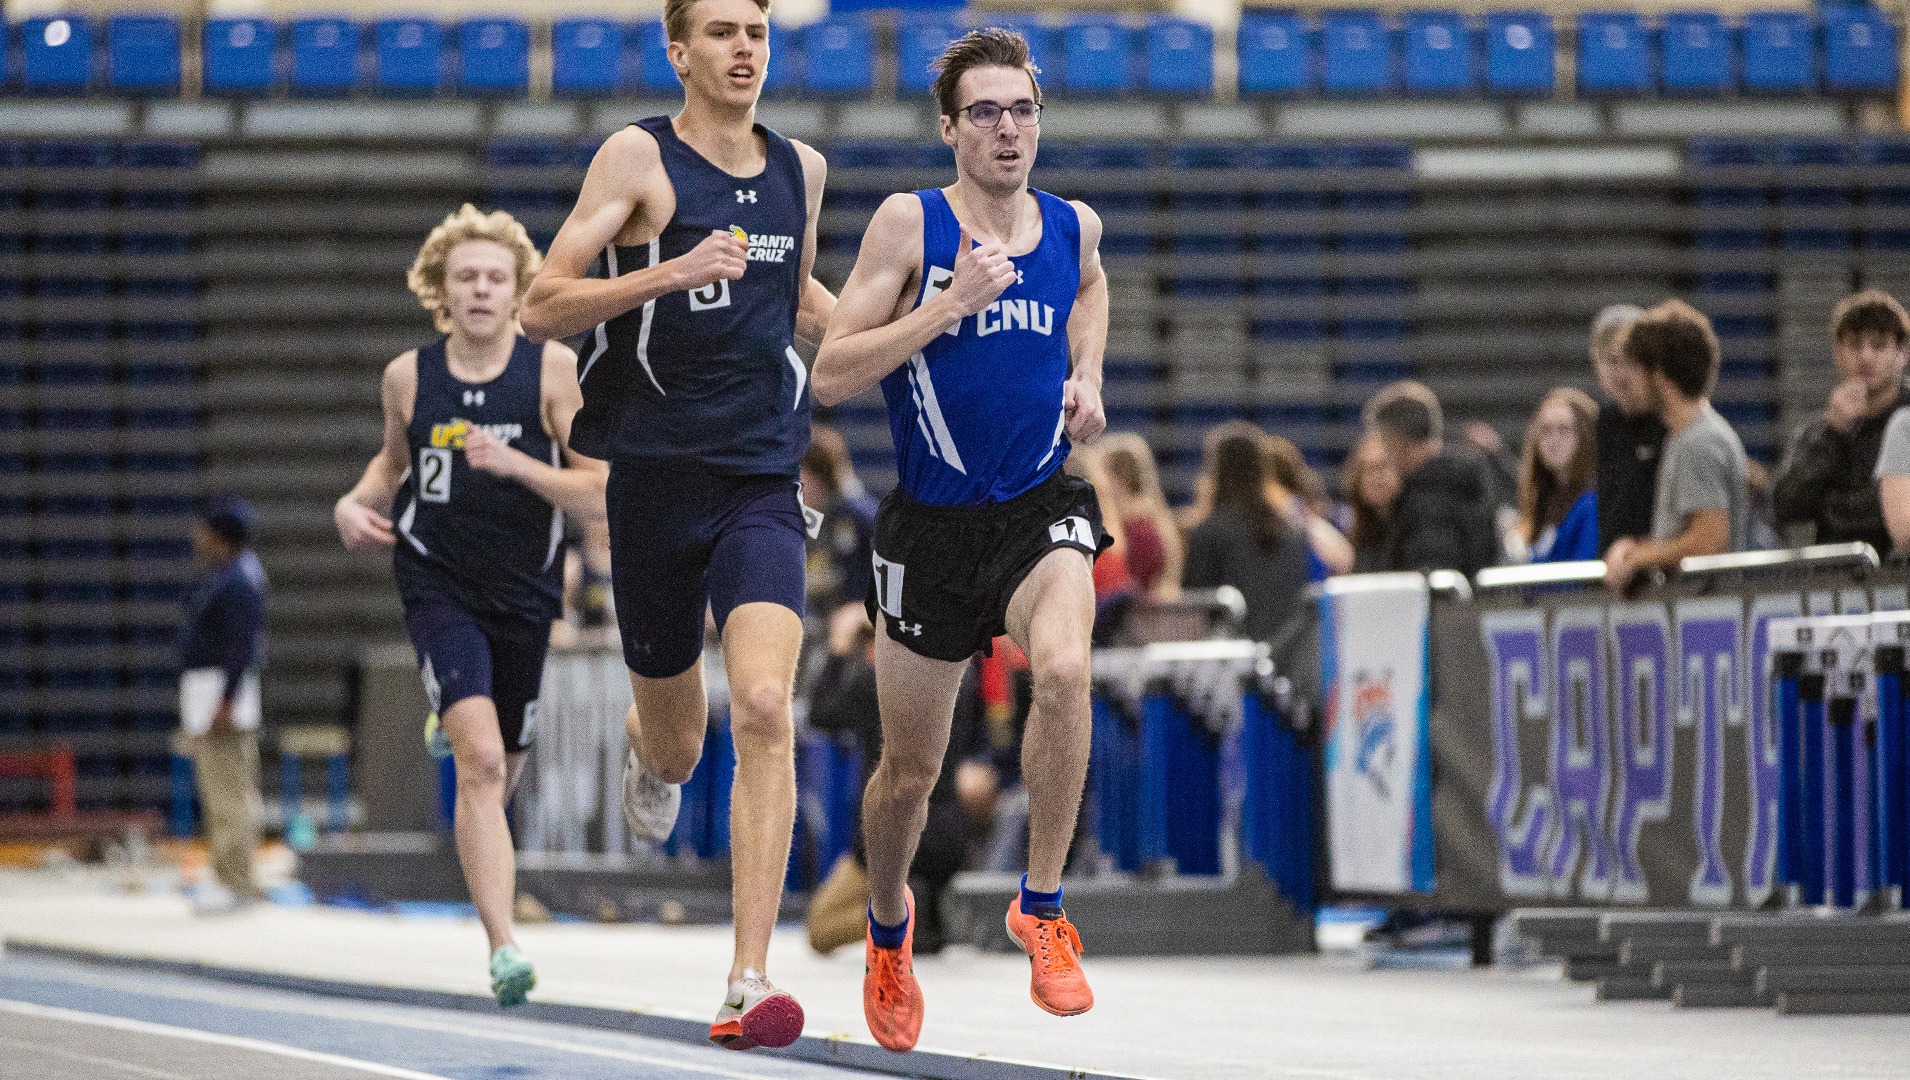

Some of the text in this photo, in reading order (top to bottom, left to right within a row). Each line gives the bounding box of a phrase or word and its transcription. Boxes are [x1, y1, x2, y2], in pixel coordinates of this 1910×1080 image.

[746, 248, 786, 262] CRUZ
[748, 234, 795, 251] SANTA
[976, 298, 1055, 337] CNU
[426, 455, 442, 495] 2
